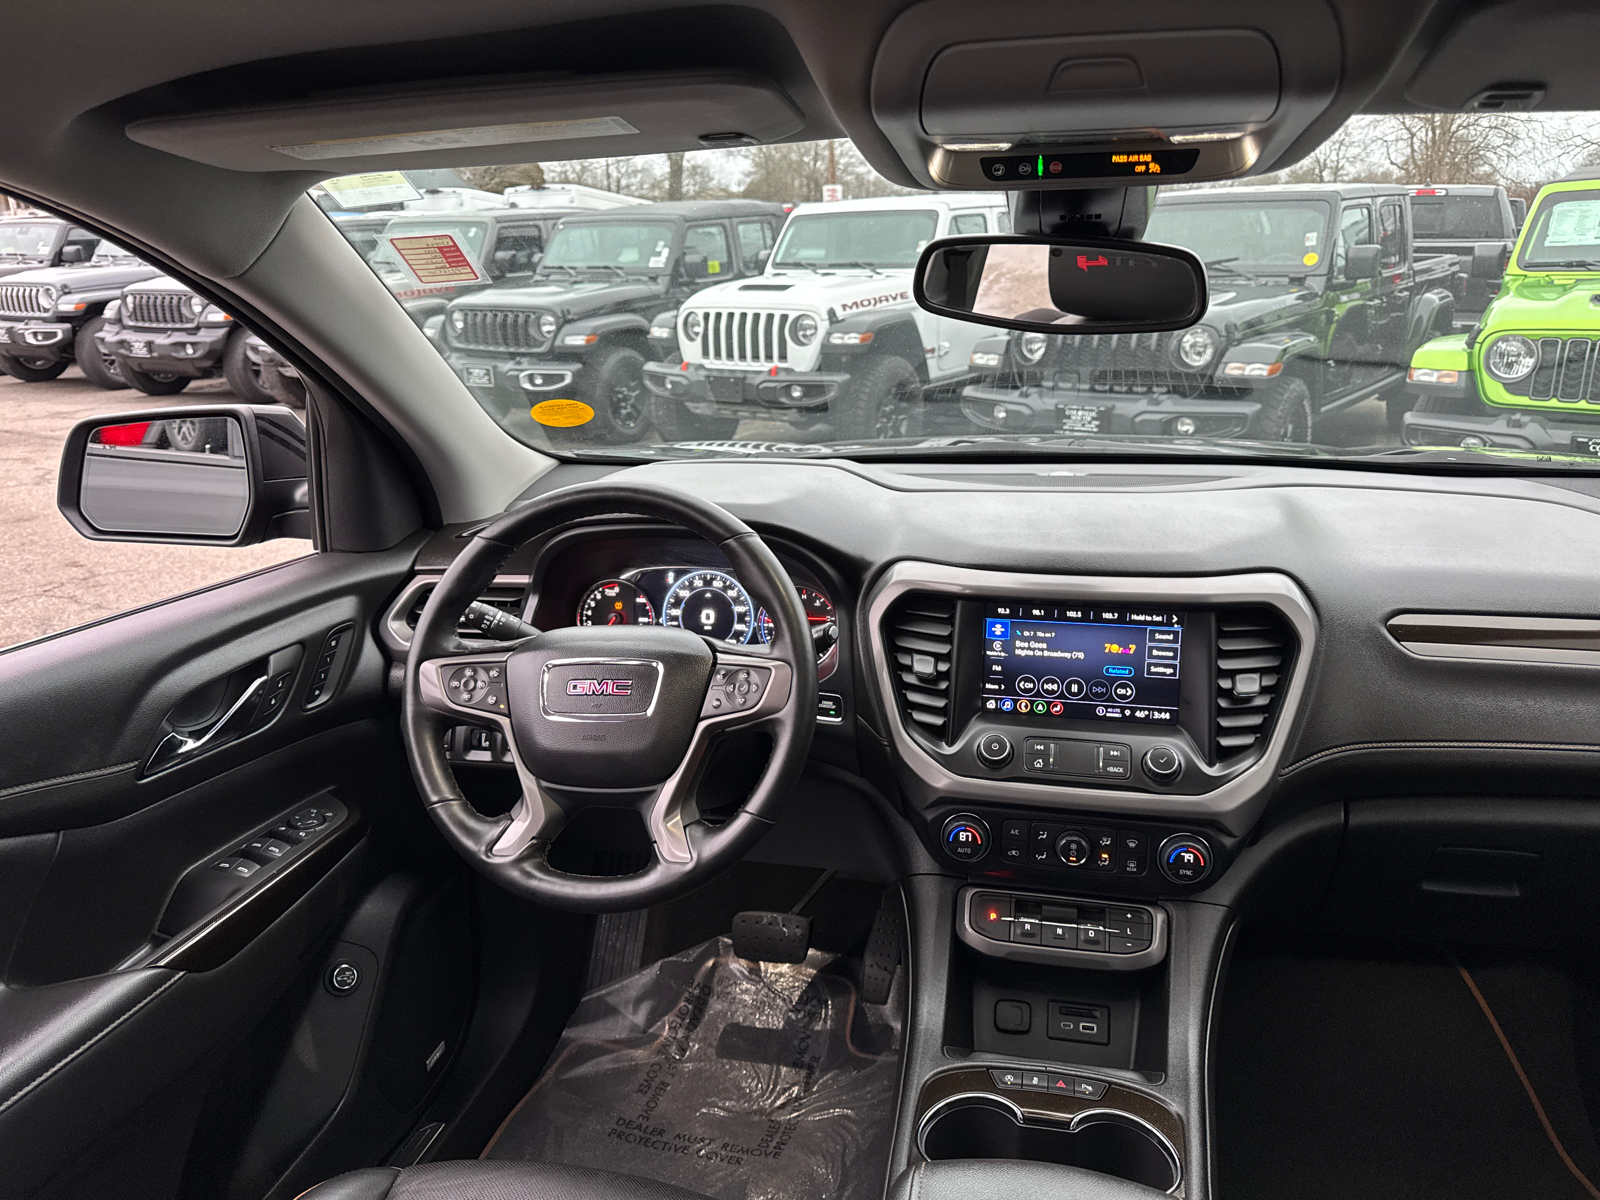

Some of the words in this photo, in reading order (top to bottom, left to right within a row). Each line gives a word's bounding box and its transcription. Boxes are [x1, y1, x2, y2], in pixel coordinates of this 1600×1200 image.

[1112, 154, 1128, 162] PASS
[841, 292, 909, 312] MOJAVE
[701, 609, 715, 624] 0
[1150, 666, 1174, 674] Settings
[566, 680, 632, 695] GMC
[1153, 711, 1170, 719] 3:44
[959, 832, 972, 842] 87
[636, 1062, 662, 1096] COVER
[638, 1080, 670, 1122] REMOVE
[616, 1117, 666, 1138] DEALER
[673, 1132, 716, 1146] MUST
[720, 1142, 782, 1160] REMOVE
[758, 1118, 782, 1148] DEALER
[608, 1128, 691, 1156] PROTECTIVE
[696, 1149, 744, 1166] COVER
